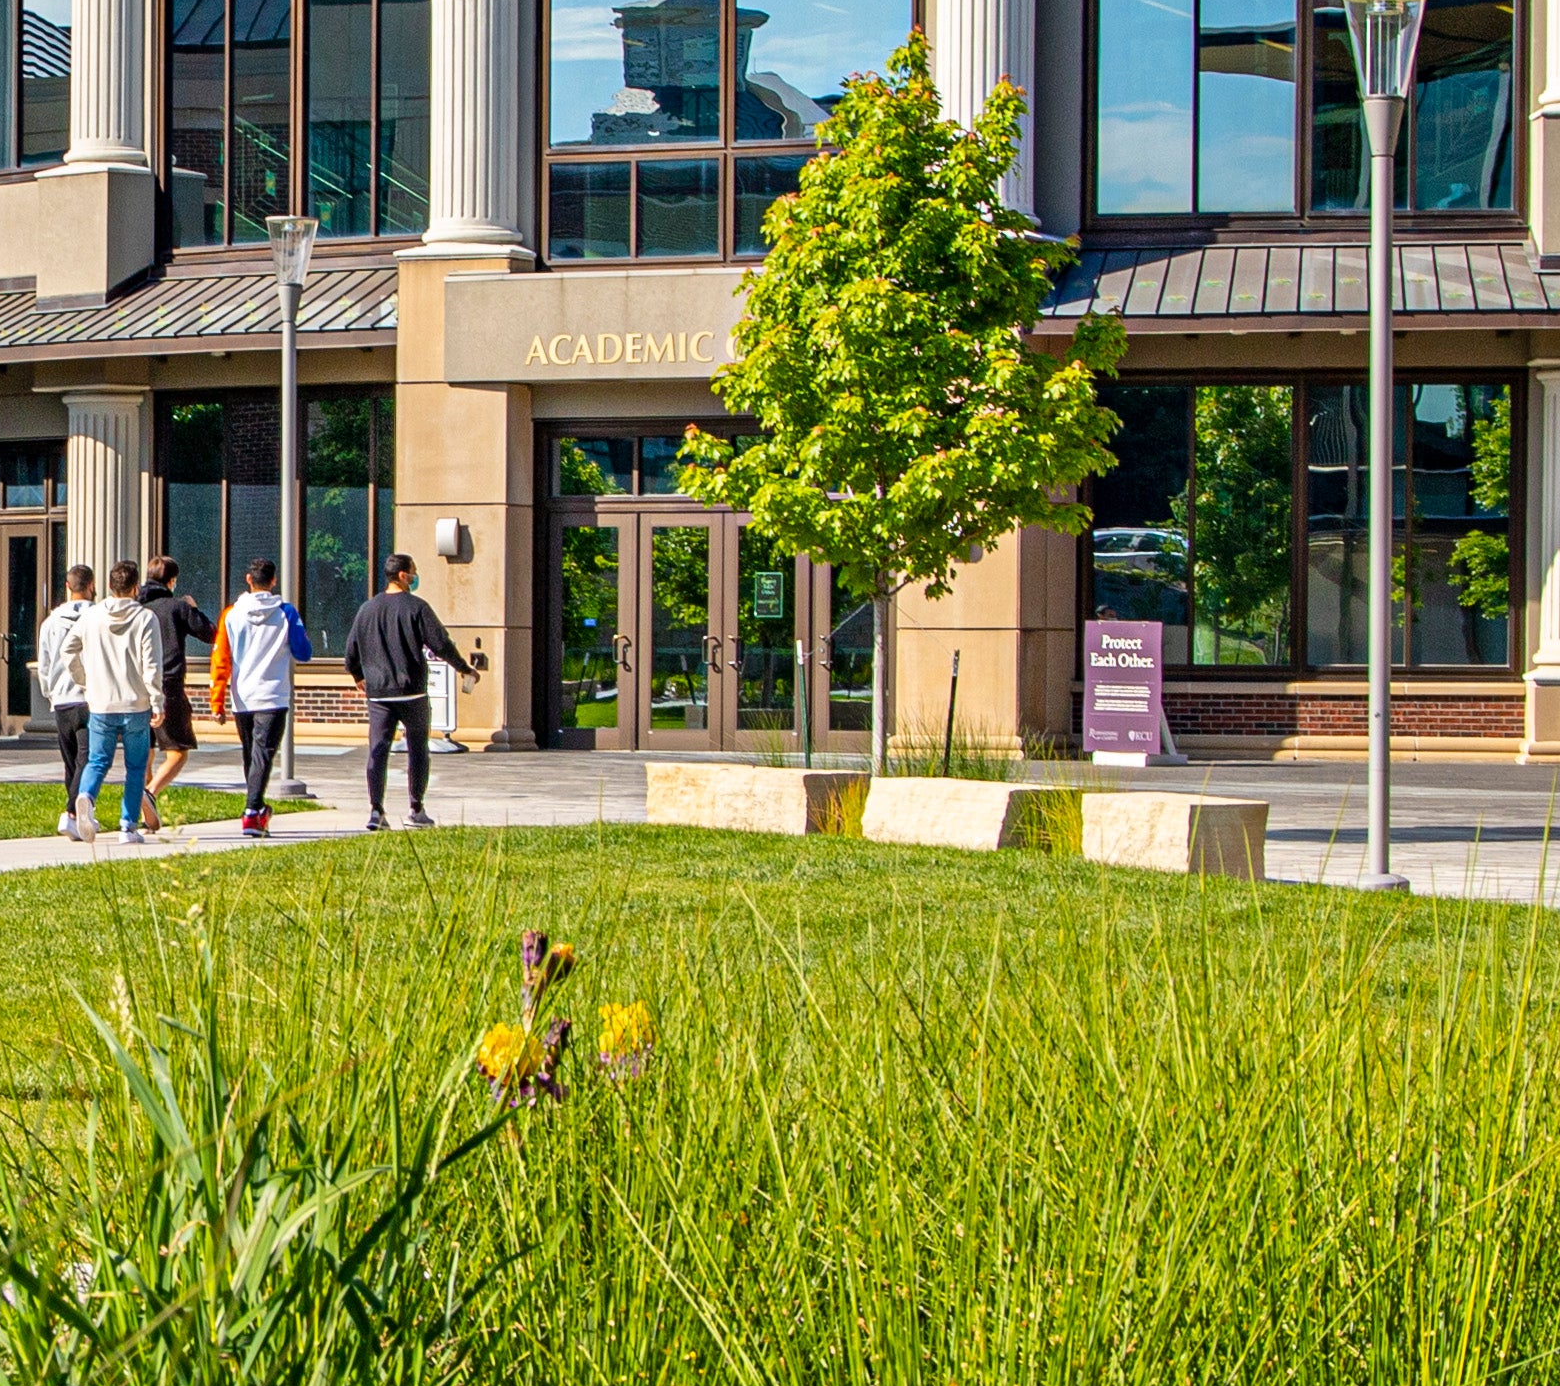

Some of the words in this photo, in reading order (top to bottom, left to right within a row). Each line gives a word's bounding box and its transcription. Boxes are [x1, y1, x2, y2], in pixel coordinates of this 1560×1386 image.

[525, 331, 714, 365] ACADEMIC
[1102, 634, 1142, 650] Protect
[1090, 652, 1117, 667] Each
[1118, 653, 1155, 668] Other.
